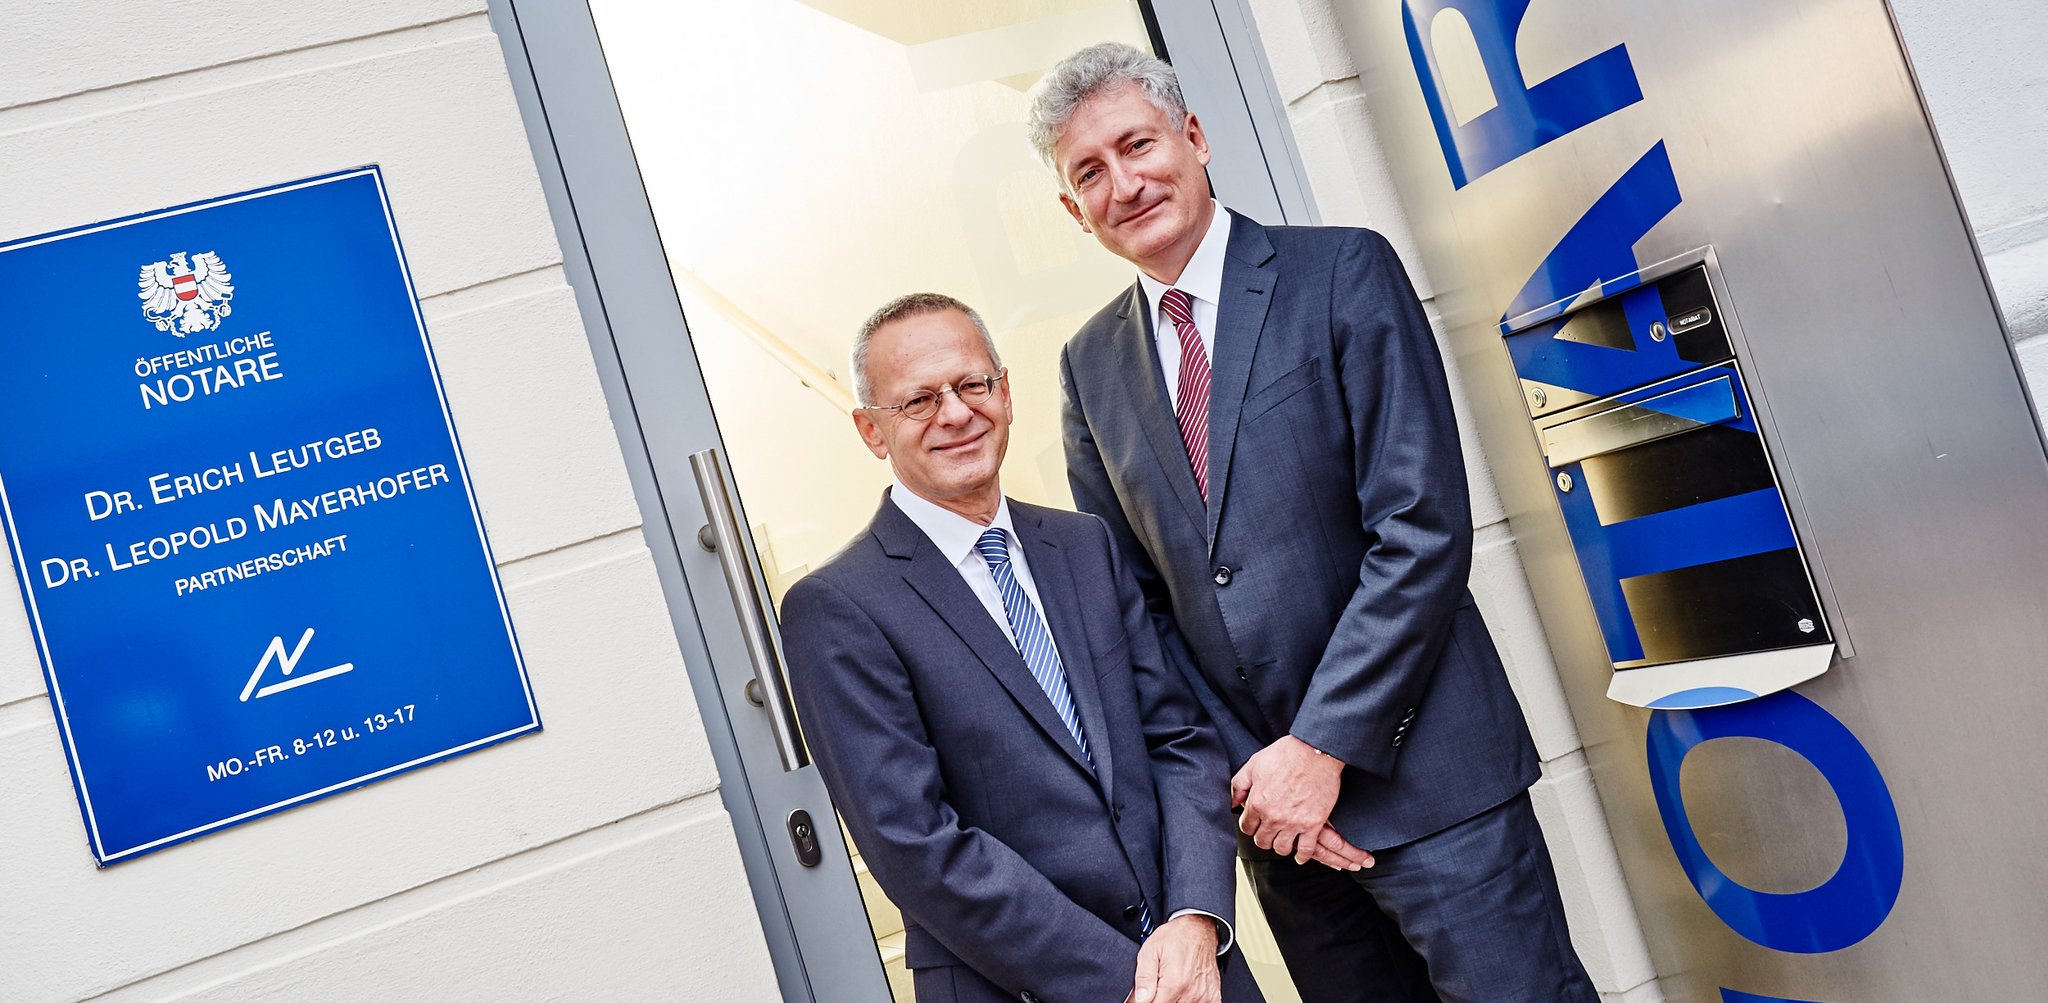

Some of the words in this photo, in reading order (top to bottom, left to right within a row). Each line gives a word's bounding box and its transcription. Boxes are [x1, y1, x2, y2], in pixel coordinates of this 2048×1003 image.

[134, 330, 275, 377] ÖFFENTLICHE
[140, 352, 284, 410] NOTARE
[84, 490, 143, 521] DR.
[148, 462, 245, 505] ERICH
[249, 428, 382, 479] LEUTGEB
[1401, 0, 1904, 1003] OTAR
[41, 556, 100, 589] DR.
[105, 517, 248, 572] LEOPOLD
[253, 463, 450, 532] MAYERHOFER
[174, 535, 348, 597] PARTNERSCHAFT
[206, 746, 290, 782] MO.-FR.
[292, 729, 338, 756] 8-12
[341, 728, 360, 742] u.
[363, 704, 416, 733] 13-17
